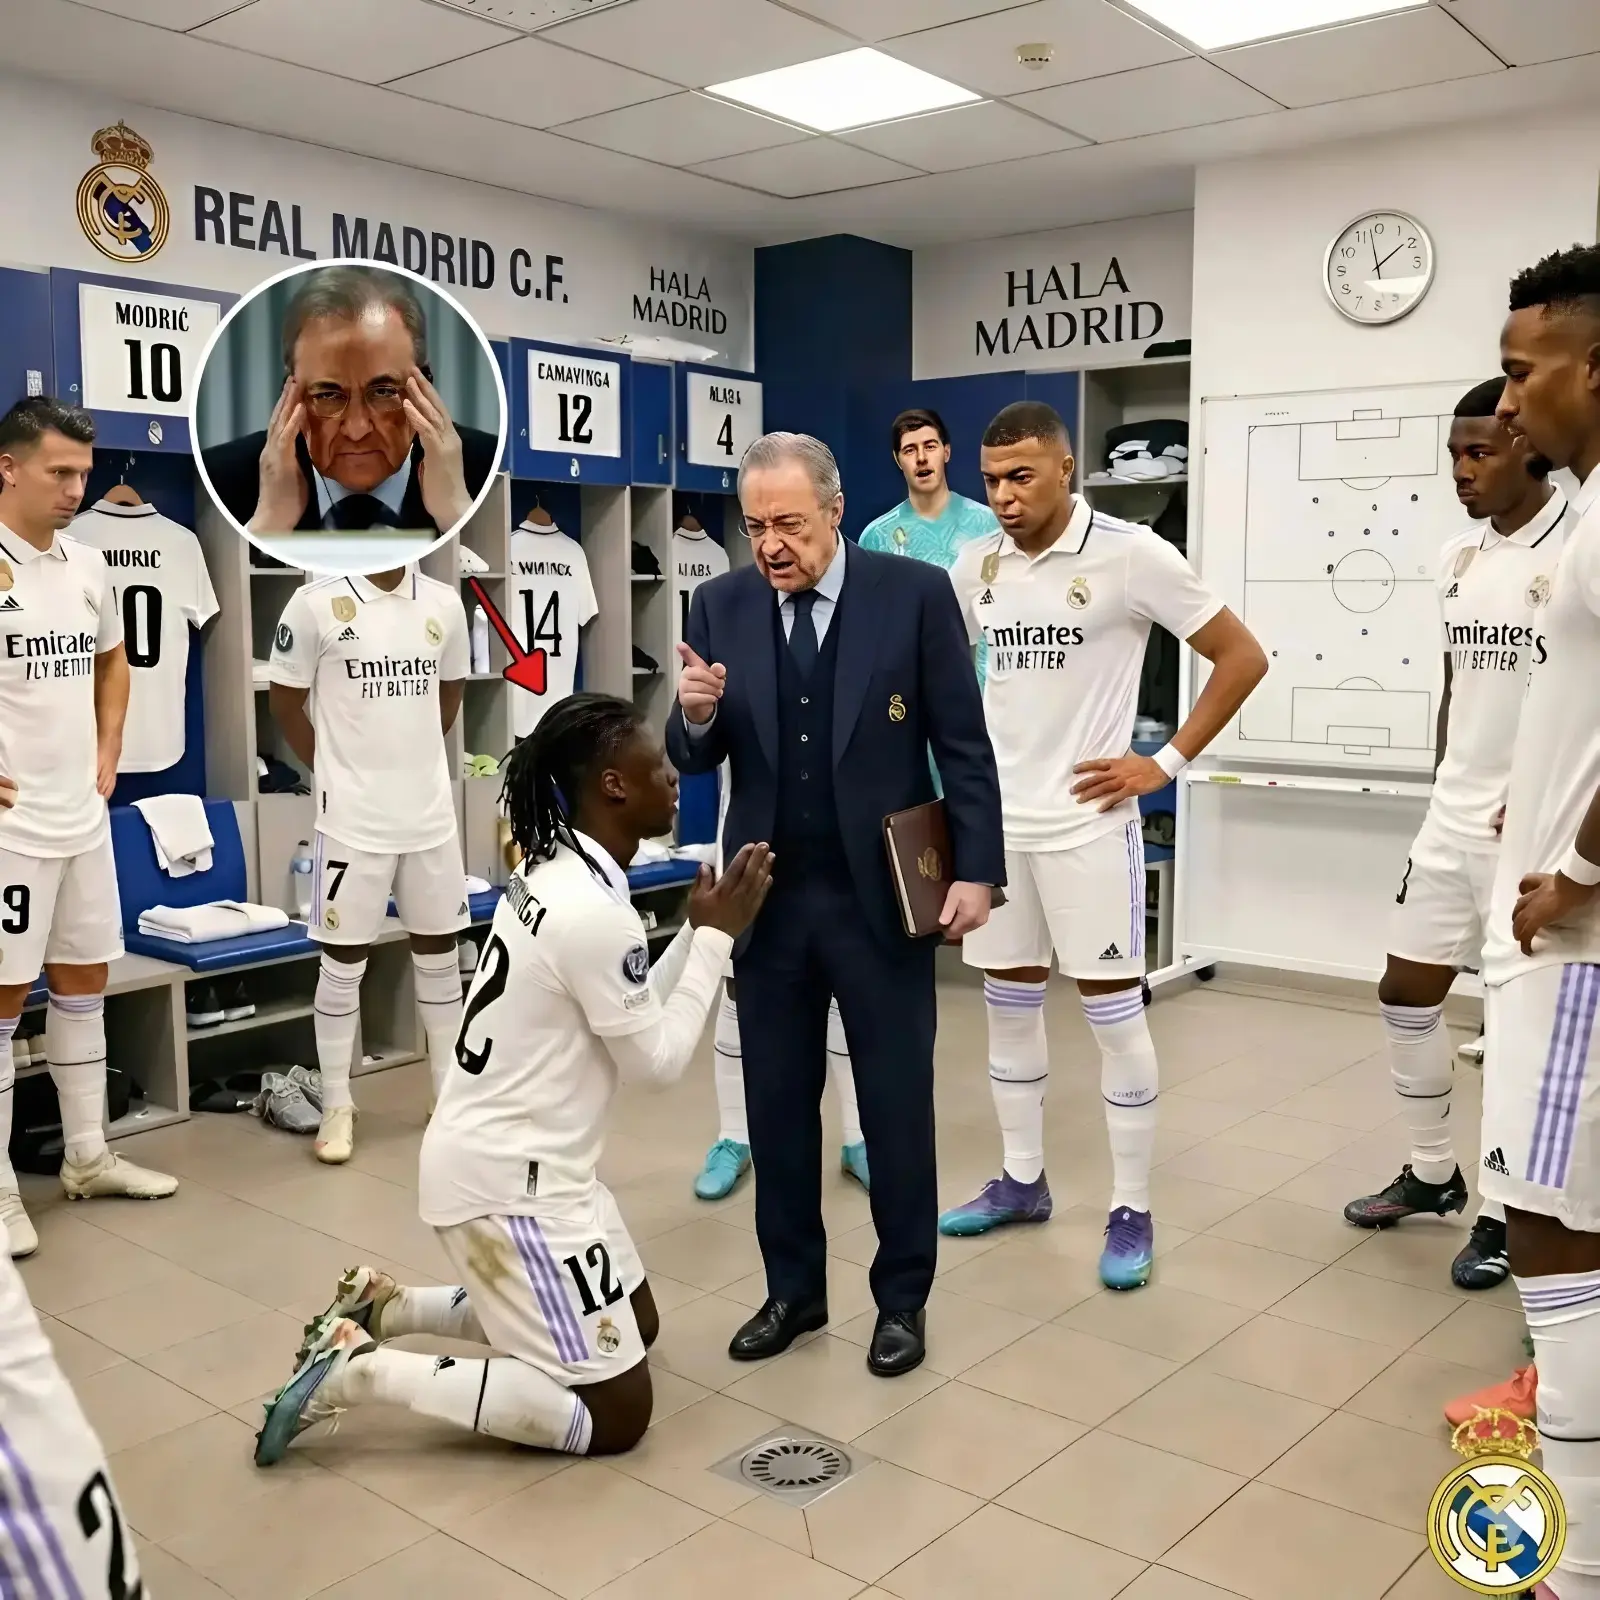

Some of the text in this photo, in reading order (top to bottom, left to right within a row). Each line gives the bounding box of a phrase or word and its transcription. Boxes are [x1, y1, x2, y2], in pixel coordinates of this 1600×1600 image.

[194, 185, 568, 303] REAL MADRID C.F.
[1340, 246, 1356, 258] 10
[1407, 237, 1417, 249] 2
[650, 266, 711, 303] HALA
[1004, 257, 1131, 307] HALA
[115, 301, 190, 332] MODRIĆ
[633, 294, 727, 335] MADRID
[976, 301, 1164, 356] MADRID
[124, 338, 183, 403] 10
[557, 393, 593, 444] 12
[716, 413, 734, 456] 4
[518, 588, 563, 657] 14
[344, 655, 438, 679] Emirates
[326, 860, 349, 901] 7
[563, 1242, 624, 1317] 12
